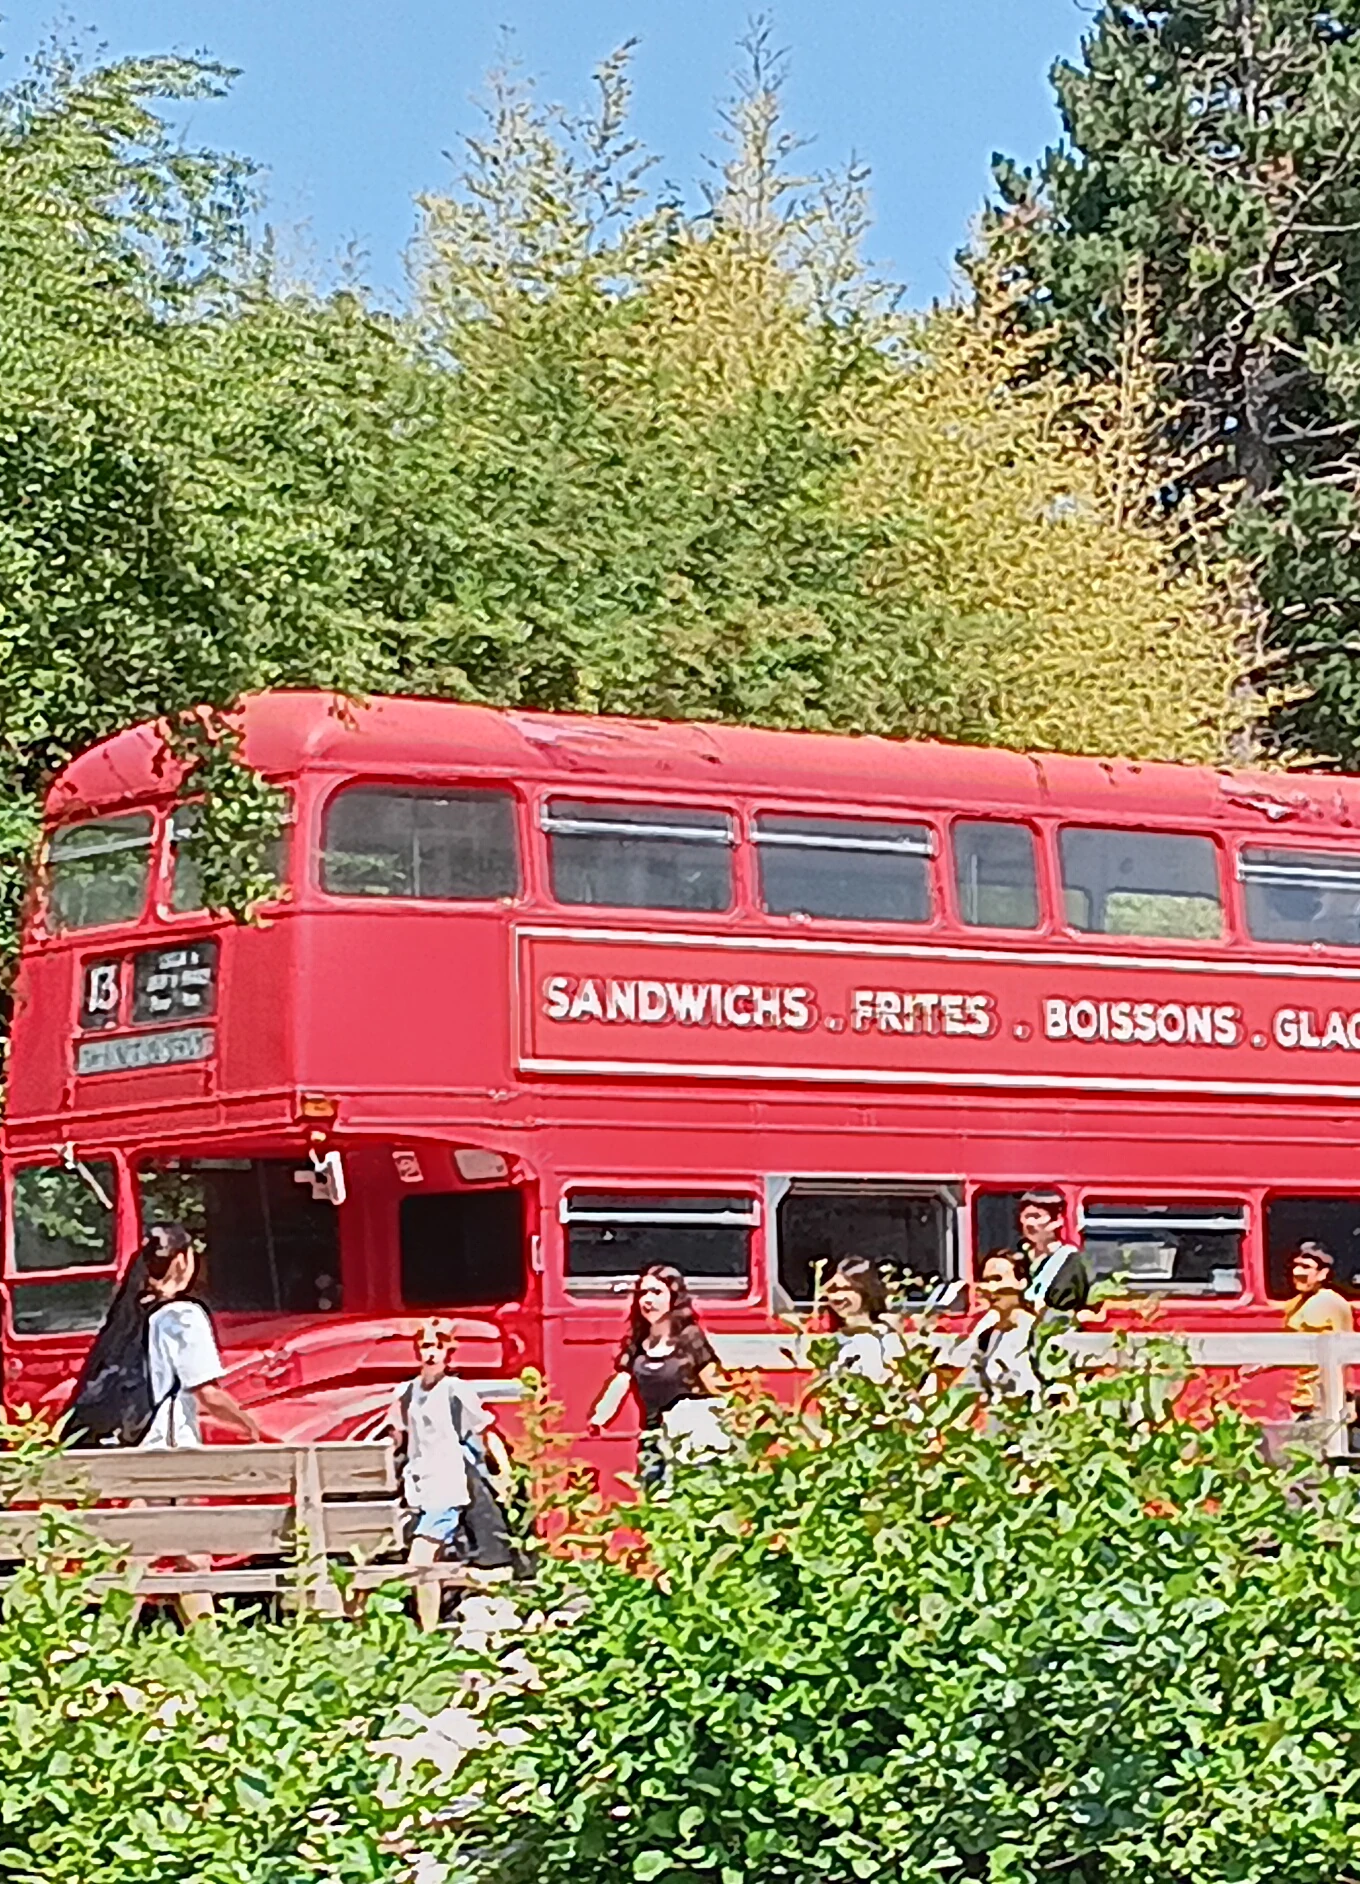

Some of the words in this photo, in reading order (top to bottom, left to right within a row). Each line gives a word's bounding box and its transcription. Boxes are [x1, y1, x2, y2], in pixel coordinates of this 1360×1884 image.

[543, 976, 814, 1028] SANDWICHS
[854, 990, 996, 1037] FRITES
[1042, 999, 1240, 1047] BOISSONS
